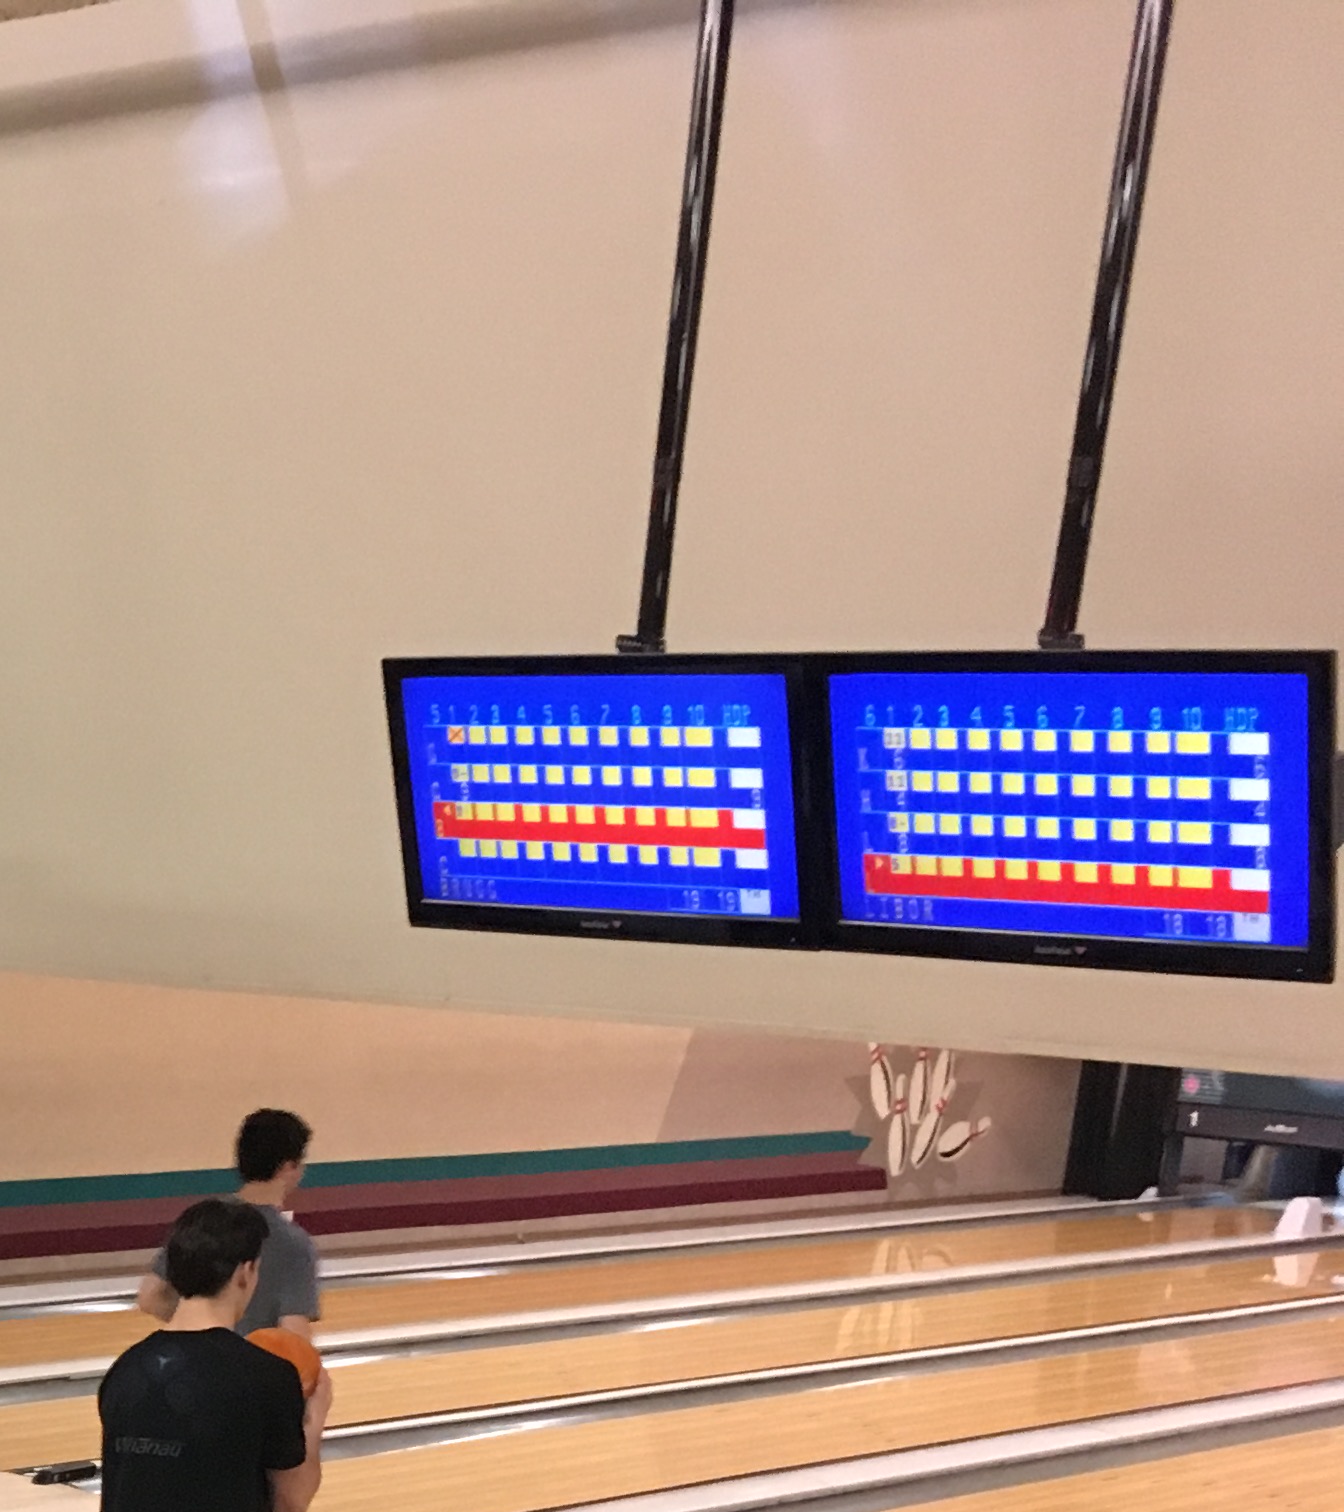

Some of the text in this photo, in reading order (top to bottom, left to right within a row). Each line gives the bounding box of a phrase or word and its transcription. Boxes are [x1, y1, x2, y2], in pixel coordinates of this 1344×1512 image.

[469, 704, 480, 725] 2
[516, 705, 527, 724] 4
[543, 704, 553, 725] 5
[570, 704, 580, 725] 6
[601, 704, 610, 724] 7
[686, 704, 705, 726] 10
[913, 704, 924, 727] 2
[938, 704, 949, 727] 3
[970, 706, 982, 727] 4
[1002, 705, 1015, 729] 5
[1036, 705, 1048, 728] 6
[1074, 706, 1086, 728] 7
[1181, 706, 1203, 730] 10
